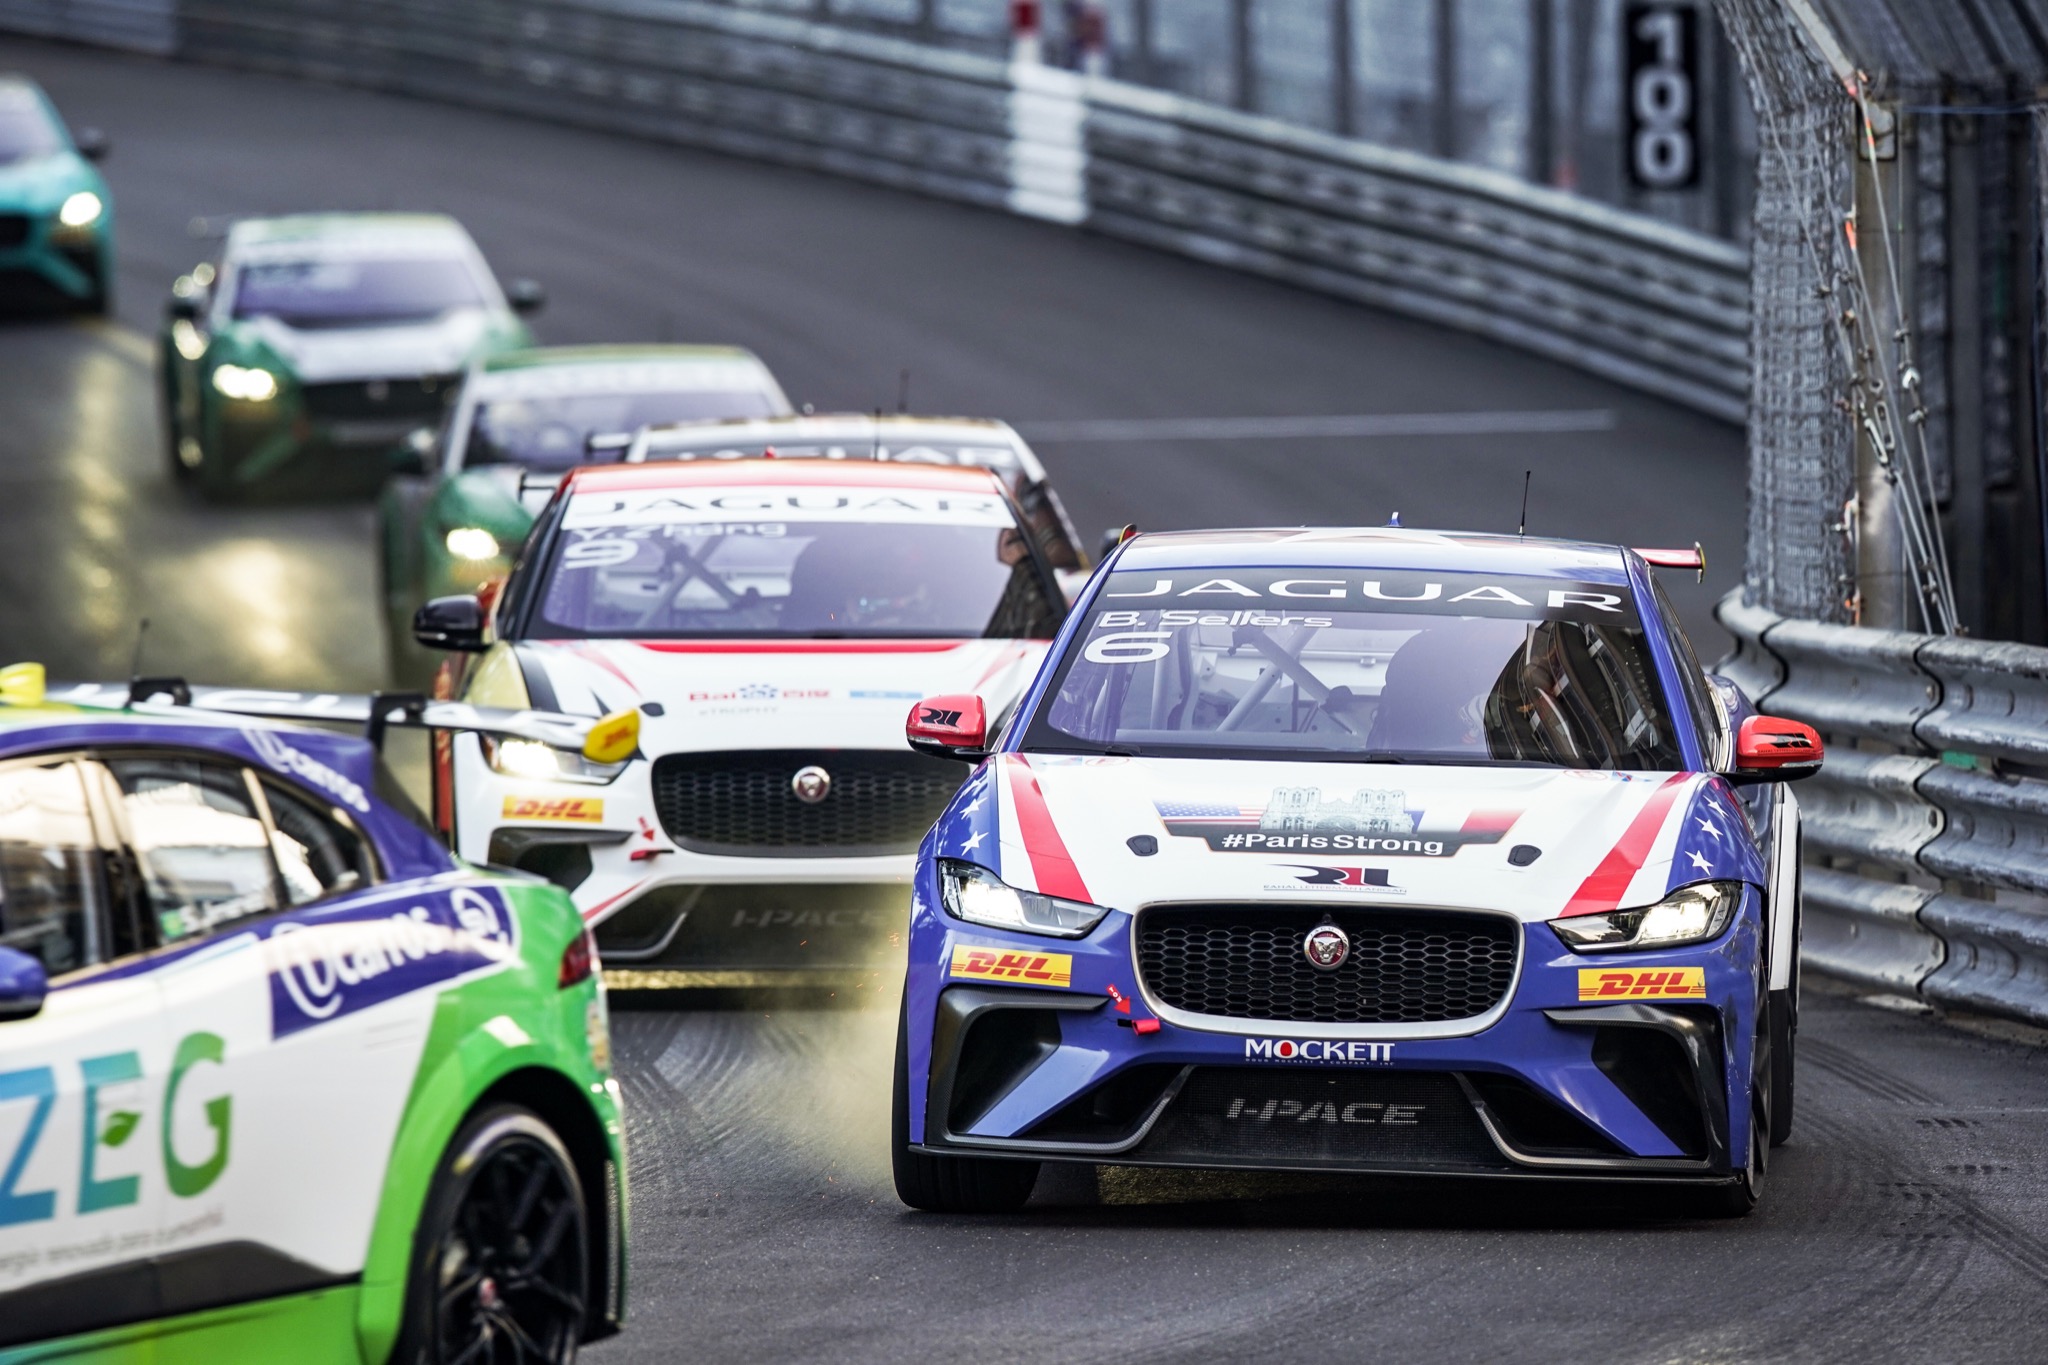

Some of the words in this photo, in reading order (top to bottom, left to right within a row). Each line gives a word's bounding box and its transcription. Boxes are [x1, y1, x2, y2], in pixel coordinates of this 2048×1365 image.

[1635, 13, 1692, 181] 100
[575, 496, 998, 517] JAGUAR
[564, 538, 639, 569] 9
[1106, 579, 1623, 612] JAGUAR
[1099, 611, 1147, 628] B.
[1159, 610, 1333, 628] Sellers
[1084, 632, 1173, 664] 6
[515, 800, 588, 818] DHL
[964, 952, 1053, 980] DHL
[1598, 972, 1691, 996] DHL
[1245, 1038, 1396, 1061] MOCKETT
[1227, 1098, 1426, 1124] I-PACE
[0, 1031, 233, 1228] ZEG
